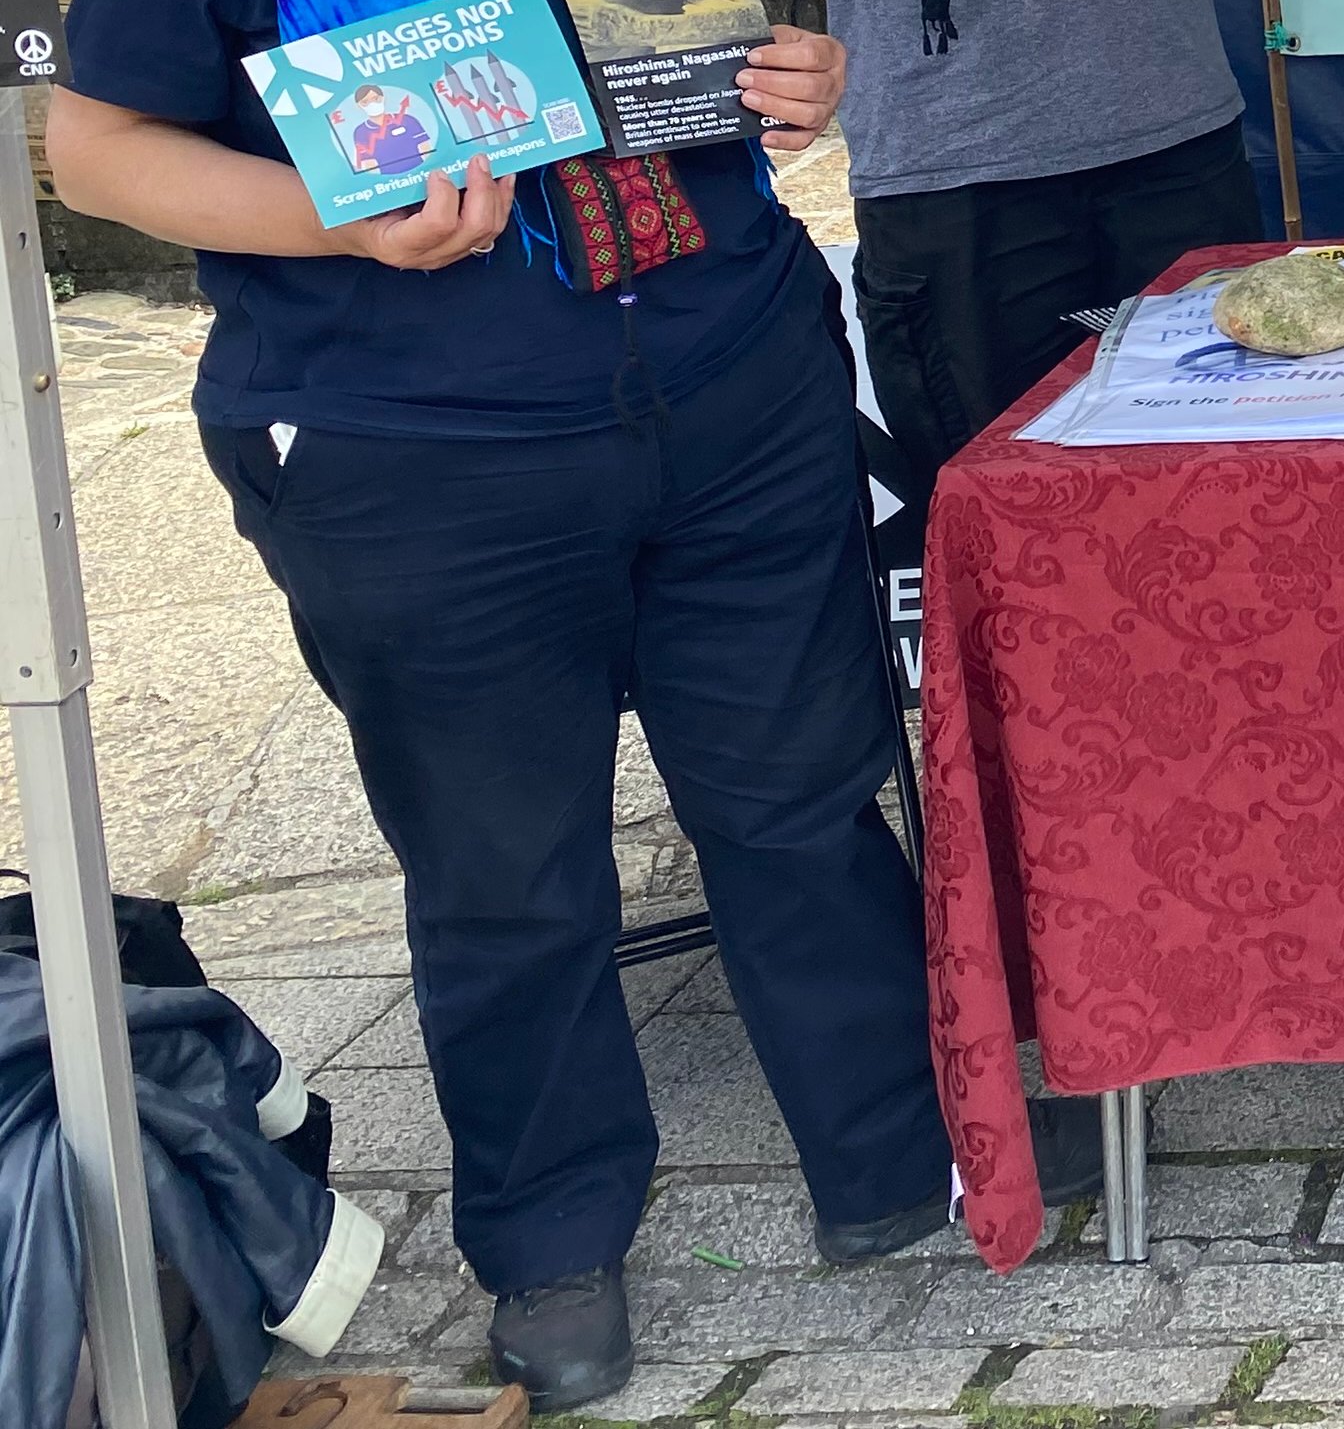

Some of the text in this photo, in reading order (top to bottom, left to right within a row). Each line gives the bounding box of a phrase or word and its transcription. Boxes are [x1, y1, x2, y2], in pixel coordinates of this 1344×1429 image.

[343, 13, 453, 58] WAGES
[353, 22, 505, 77] WEAPONS
[20, 62, 56, 76] CND
[603, 60, 679, 77] Hiroshima,
[607, 69, 691, 90] never again
[617, 103, 647, 112] Nuclear
[648, 99, 674, 108] bombs
[675, 93, 707, 106] dropped
[620, 102, 717, 121] causing utter devastation.
[333, 138, 546, 208] Scrap weapons
[1129, 394, 1331, 407] Sign the petition
